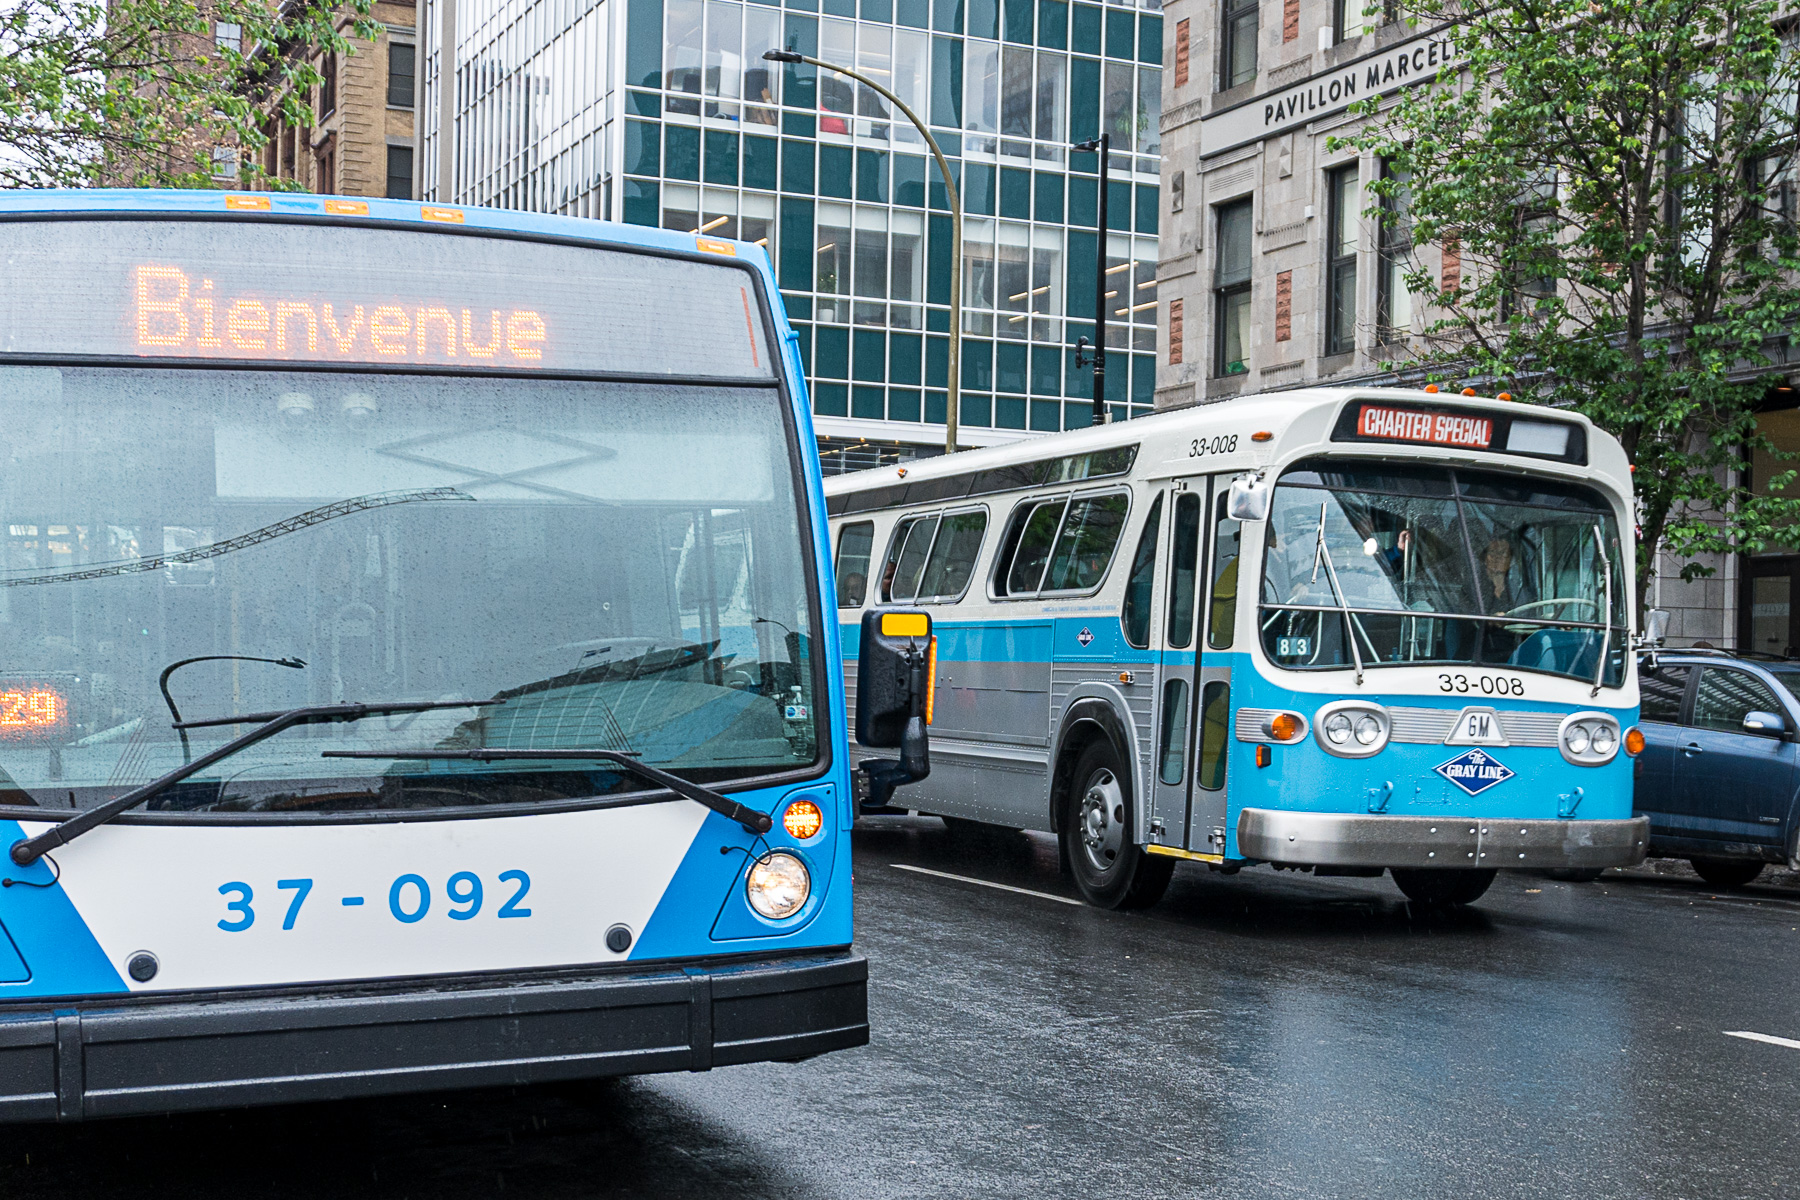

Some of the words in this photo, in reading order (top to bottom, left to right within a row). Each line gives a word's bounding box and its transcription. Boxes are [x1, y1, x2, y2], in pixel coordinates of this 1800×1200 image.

[1265, 72, 1356, 125] PAVILLON
[137, 265, 547, 360] Bienvenue
[1364, 408, 1432, 440] CHARTER
[1434, 415, 1490, 446] SPECIAL
[1189, 434, 1239, 457] 33-008
[1438, 673, 1525, 696] 33-008
[1468, 715, 1490, 737] GM
[1468, 752, 1487, 765] The
[1446, 764, 1477, 778] GRAY
[1478, 765, 1504, 779] LINE
[217, 869, 532, 933] 37-092
